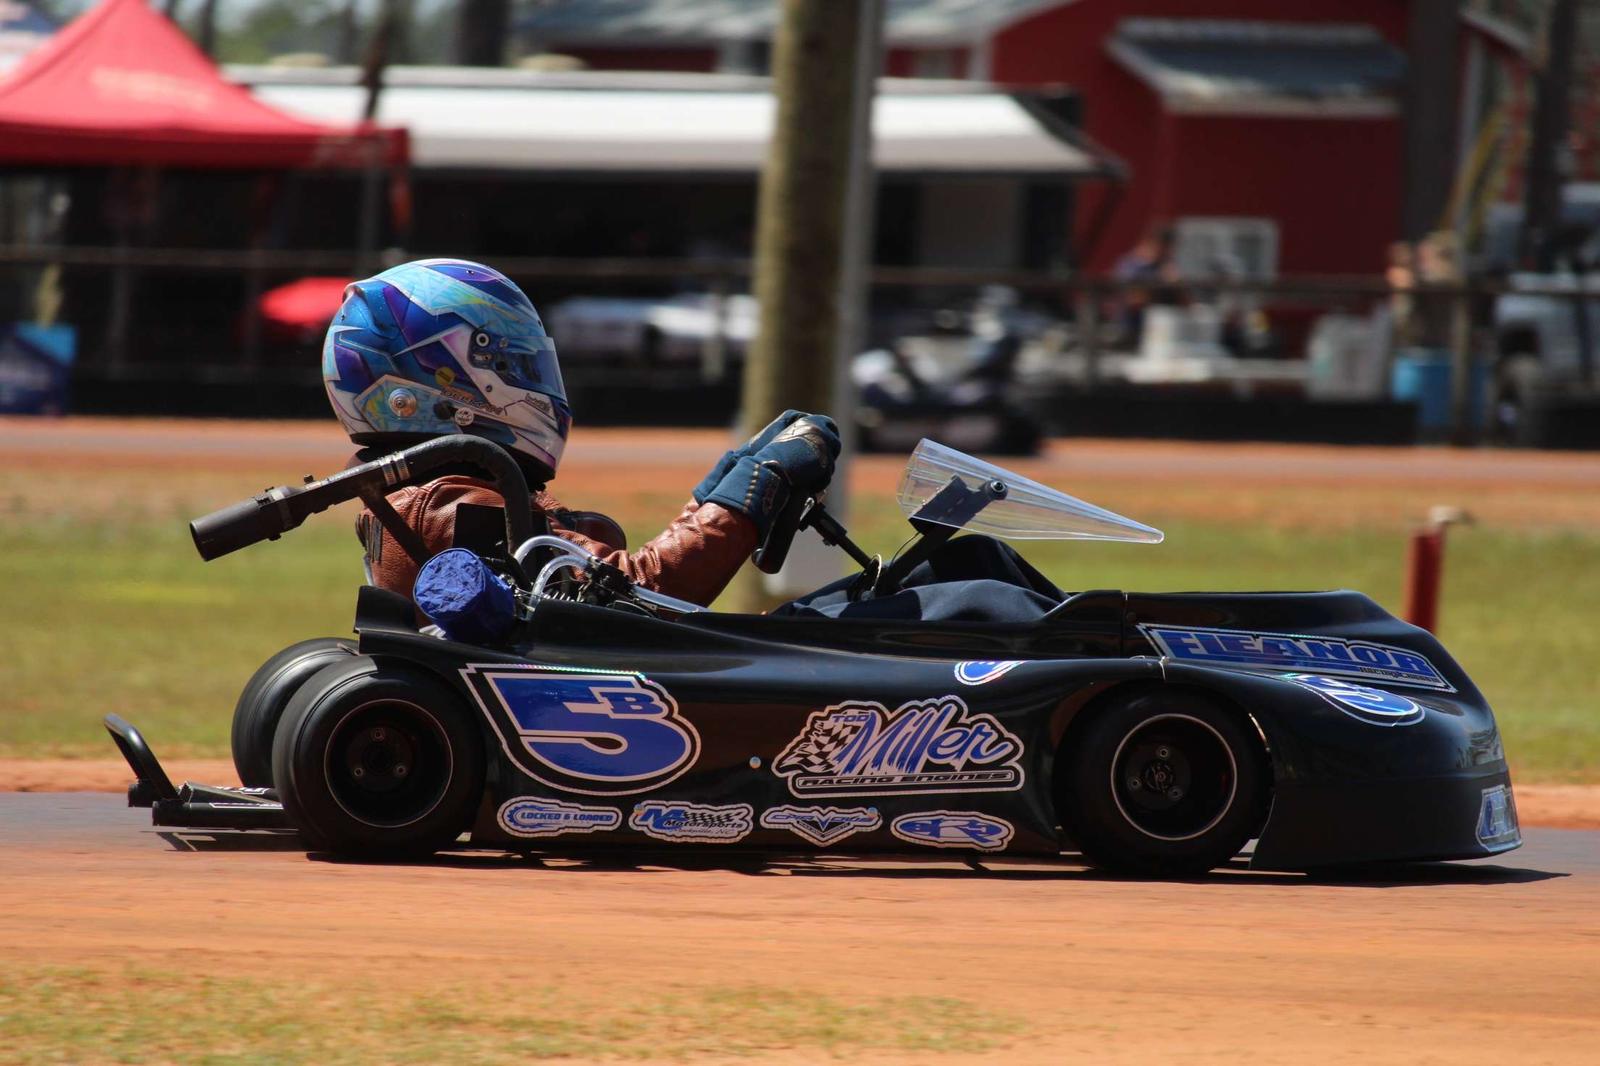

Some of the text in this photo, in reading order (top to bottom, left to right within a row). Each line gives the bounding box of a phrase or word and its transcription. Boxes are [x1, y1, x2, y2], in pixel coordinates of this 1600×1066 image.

[831, 713, 870, 723] TOD
[833, 703, 1010, 775] Miller
[800, 772, 1009, 787] RACING ENGINES
[520, 811, 561, 820] LOCKED
[573, 814, 614, 822] LOADED
[663, 819, 743, 830] Motorsports
